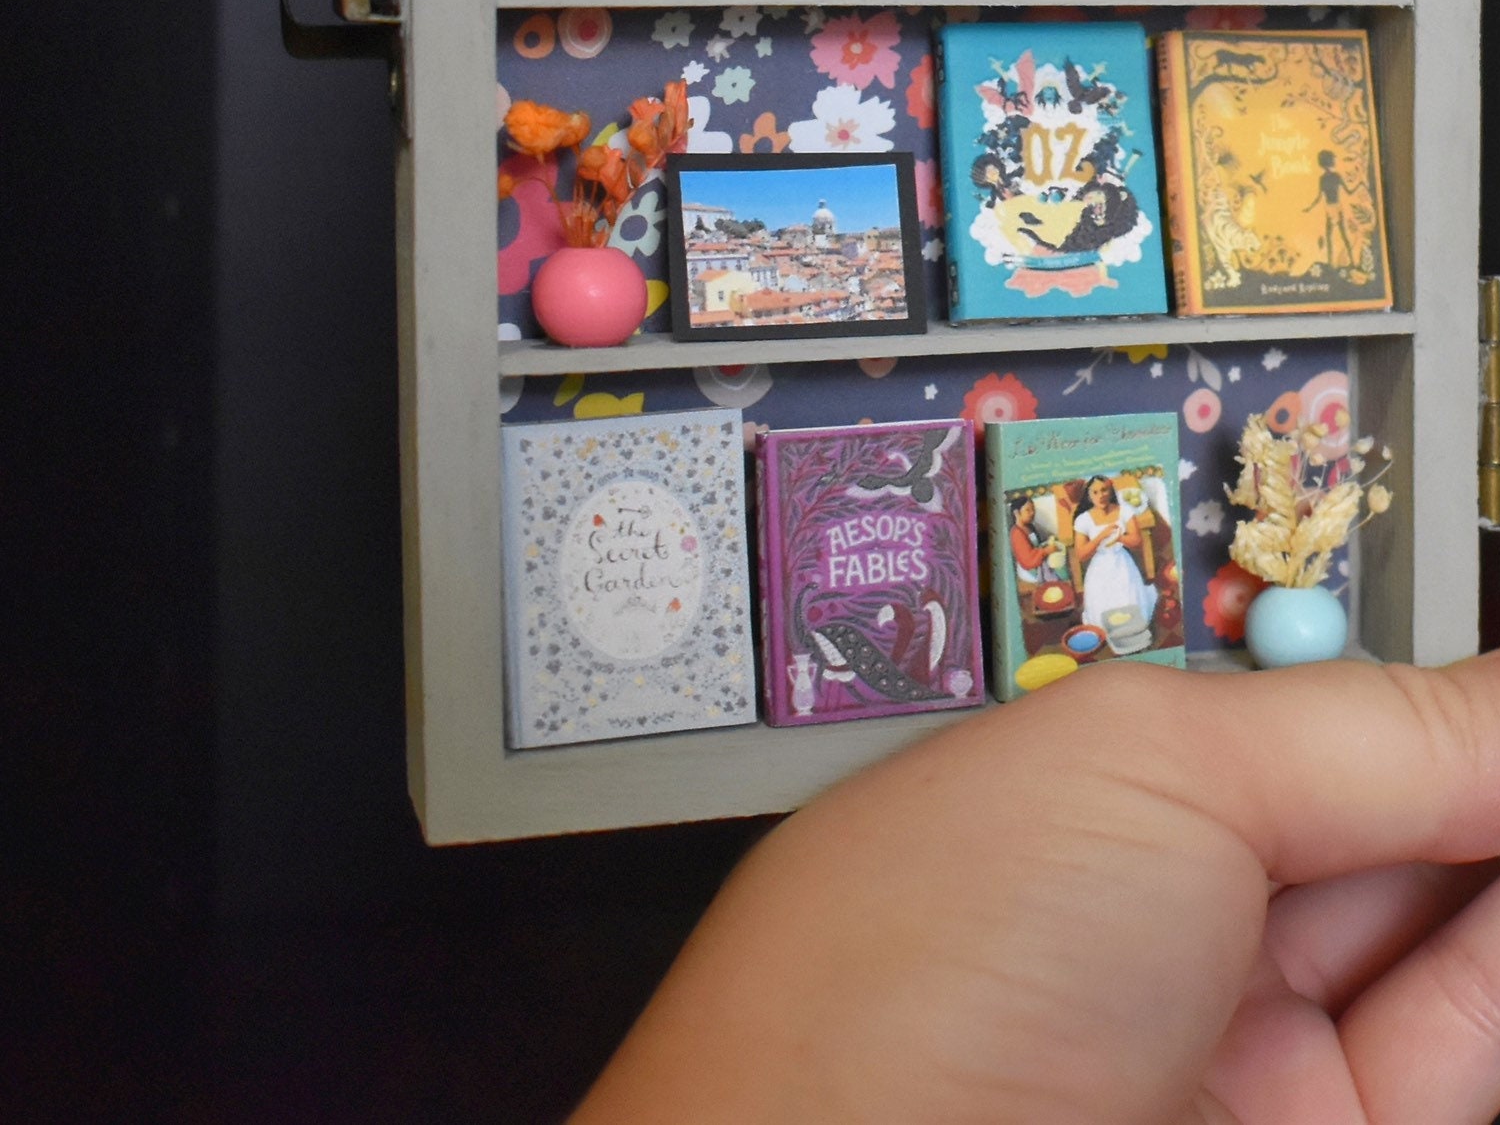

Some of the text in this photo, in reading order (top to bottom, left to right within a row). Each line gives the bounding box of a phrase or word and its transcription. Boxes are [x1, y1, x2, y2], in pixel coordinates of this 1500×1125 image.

[1021, 121, 1098, 186] OZ
[588, 528, 669, 564] Secret
[826, 516, 927, 555] AESOP'S
[828, 548, 928, 588] FABLES
